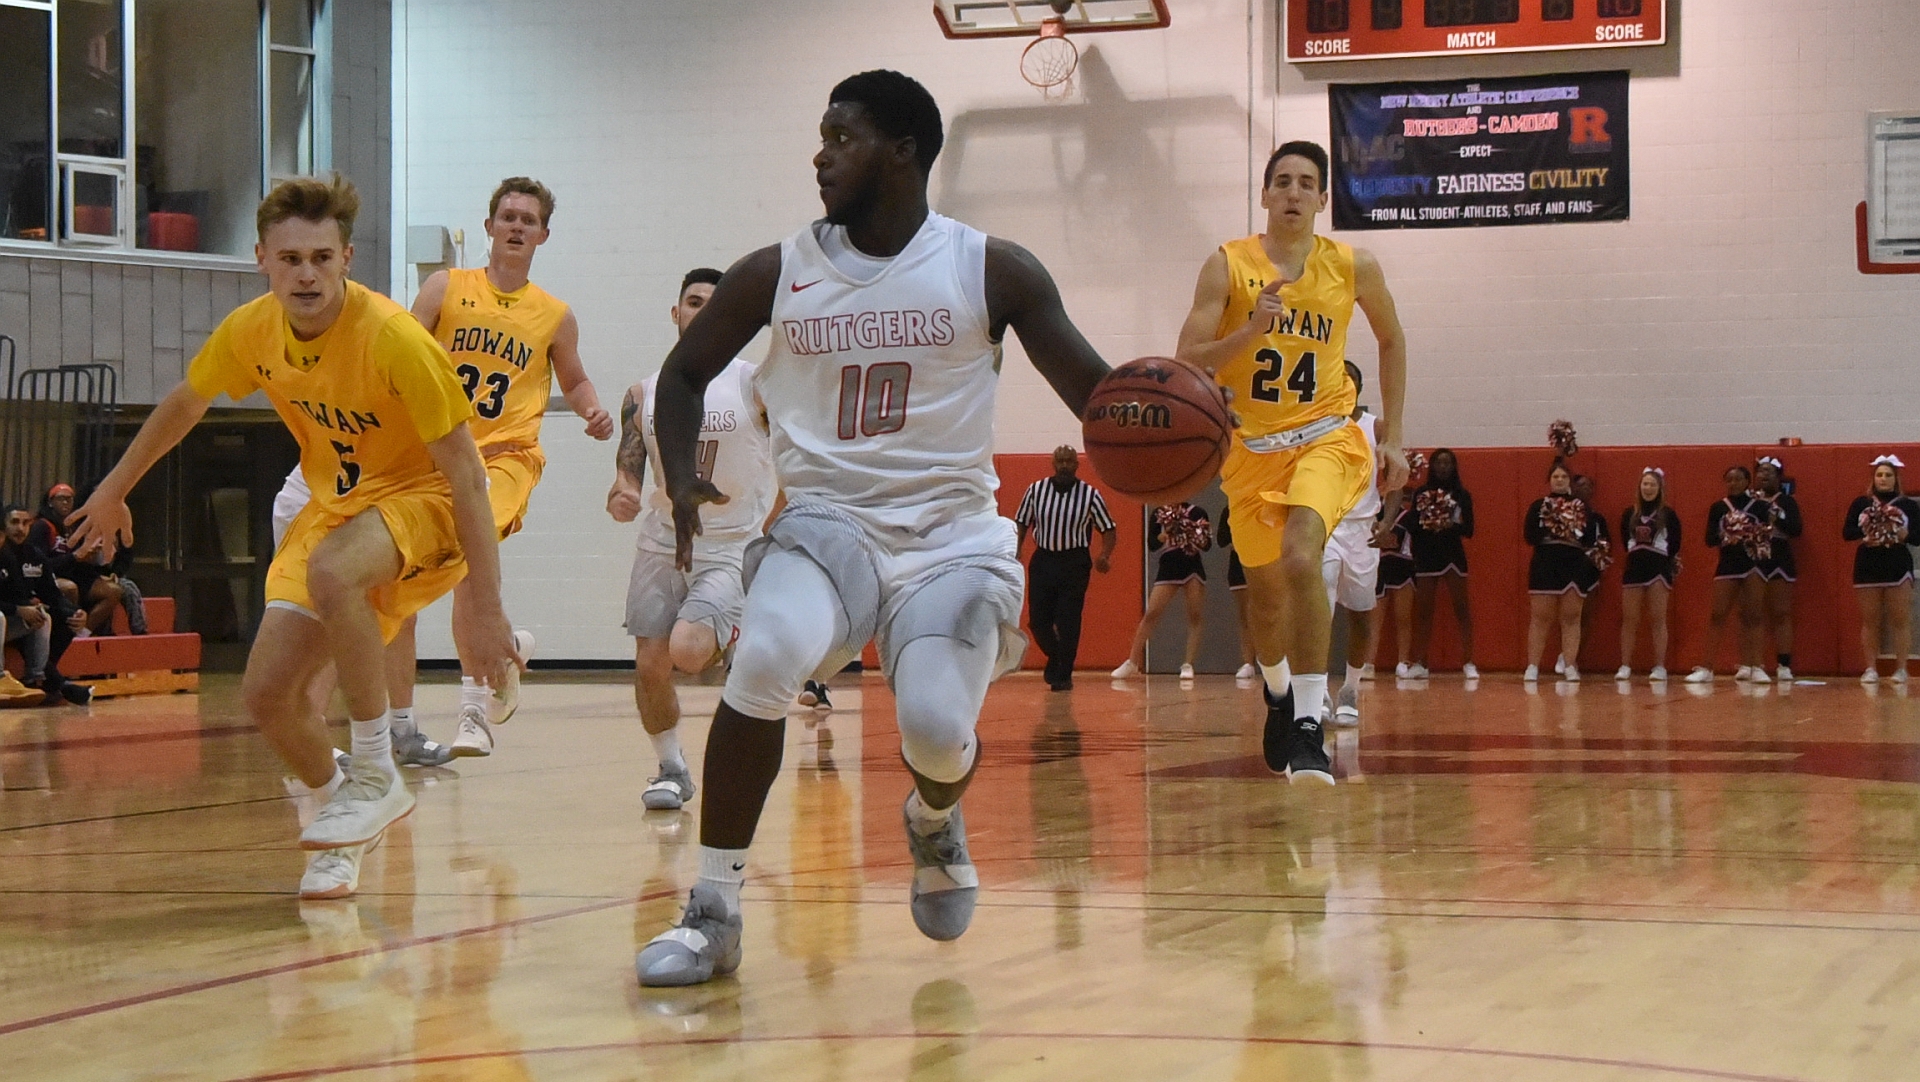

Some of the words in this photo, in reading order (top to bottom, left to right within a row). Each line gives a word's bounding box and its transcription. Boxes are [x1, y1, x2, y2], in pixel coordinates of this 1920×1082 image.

[1447, 31, 1496, 48] MATCH
[1595, 24, 1644, 41] SCORE
[1305, 39, 1350, 55] SCORE
[1380, 95, 1408, 108] NEW
[1450, 91, 1505, 106] ATHLETIC
[1466, 84, 1480, 92] THE
[1466, 106, 1482, 115] AND
[1568, 106, 1612, 144] R
[1460, 144, 1492, 157] EXPECT
[1437, 172, 1525, 194] FAIRNESS
[1529, 168, 1609, 189] CIVILITY
[1371, 208, 1398, 221] FROM
[1400, 207, 1417, 220] ALL
[1419, 203, 1511, 220] STUDENT-ATHLETES,
[1514, 202, 1543, 216] STAFF,
[1545, 201, 1565, 215] AND
[1567, 200, 1593, 213] FANS
[782, 308, 955, 355] RUTGERS
[1248, 307, 1334, 344] WAN
[450, 327, 533, 371] ROWAN
[1251, 348, 1317, 404] 24
[456, 363, 511, 419] 33
[837, 361, 912, 440] 10
[647, 410, 737, 436] RERS
[329, 438, 361, 497] 5
